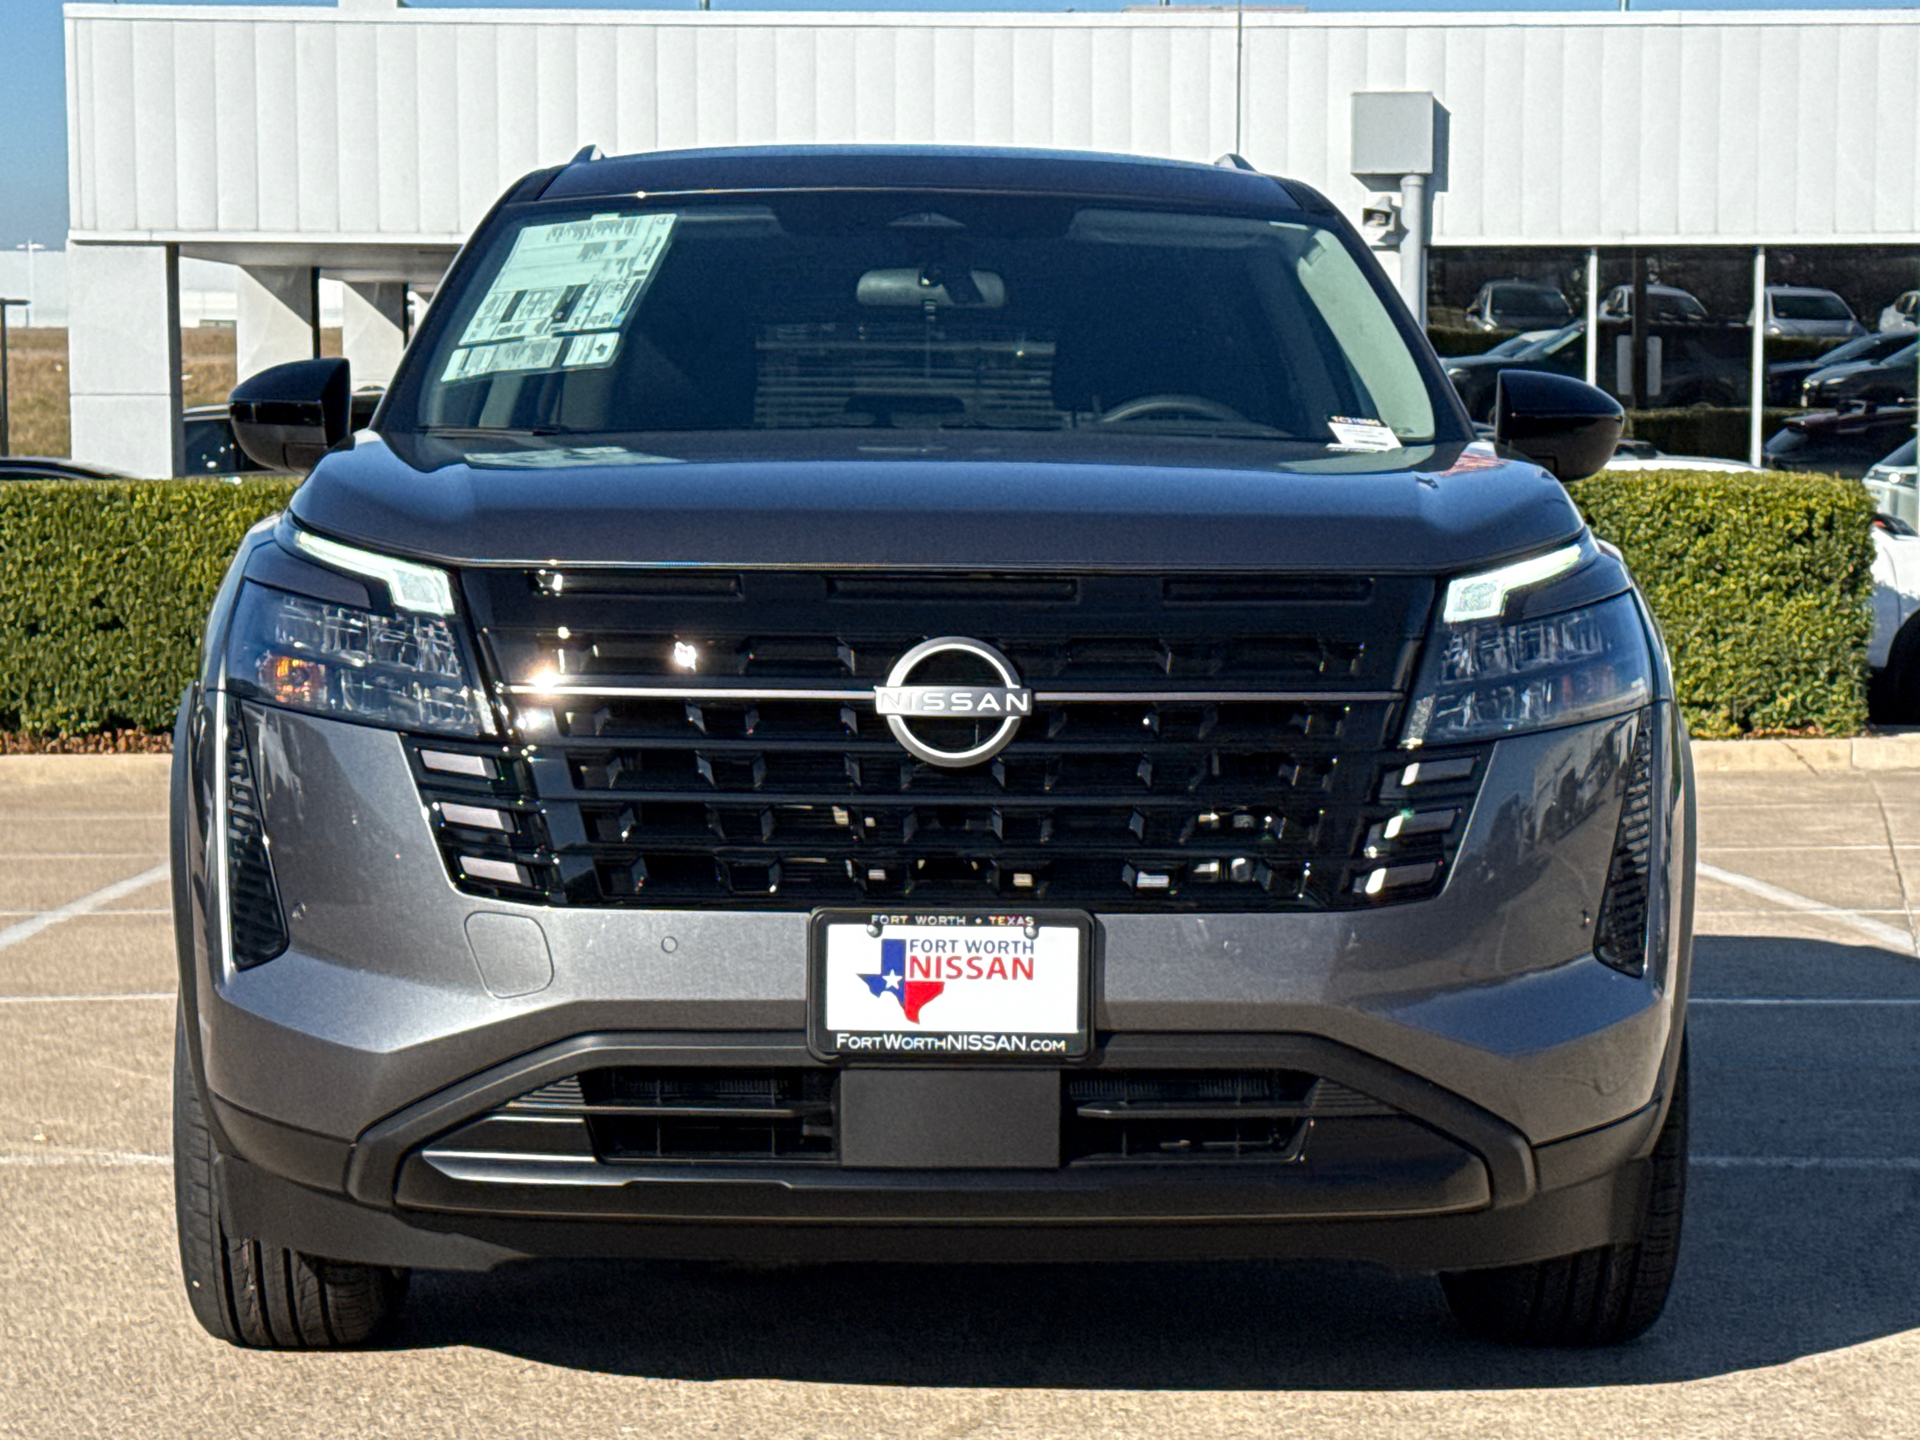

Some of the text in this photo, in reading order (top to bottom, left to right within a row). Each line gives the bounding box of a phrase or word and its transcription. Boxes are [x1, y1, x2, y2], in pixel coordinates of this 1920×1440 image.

[881, 692, 1028, 711] NISSAN
[871, 914, 1035, 926] FORT WORTH TEXAS
[909, 939, 1035, 954] FORT WORTH
[909, 955, 1034, 981] NISSAN
